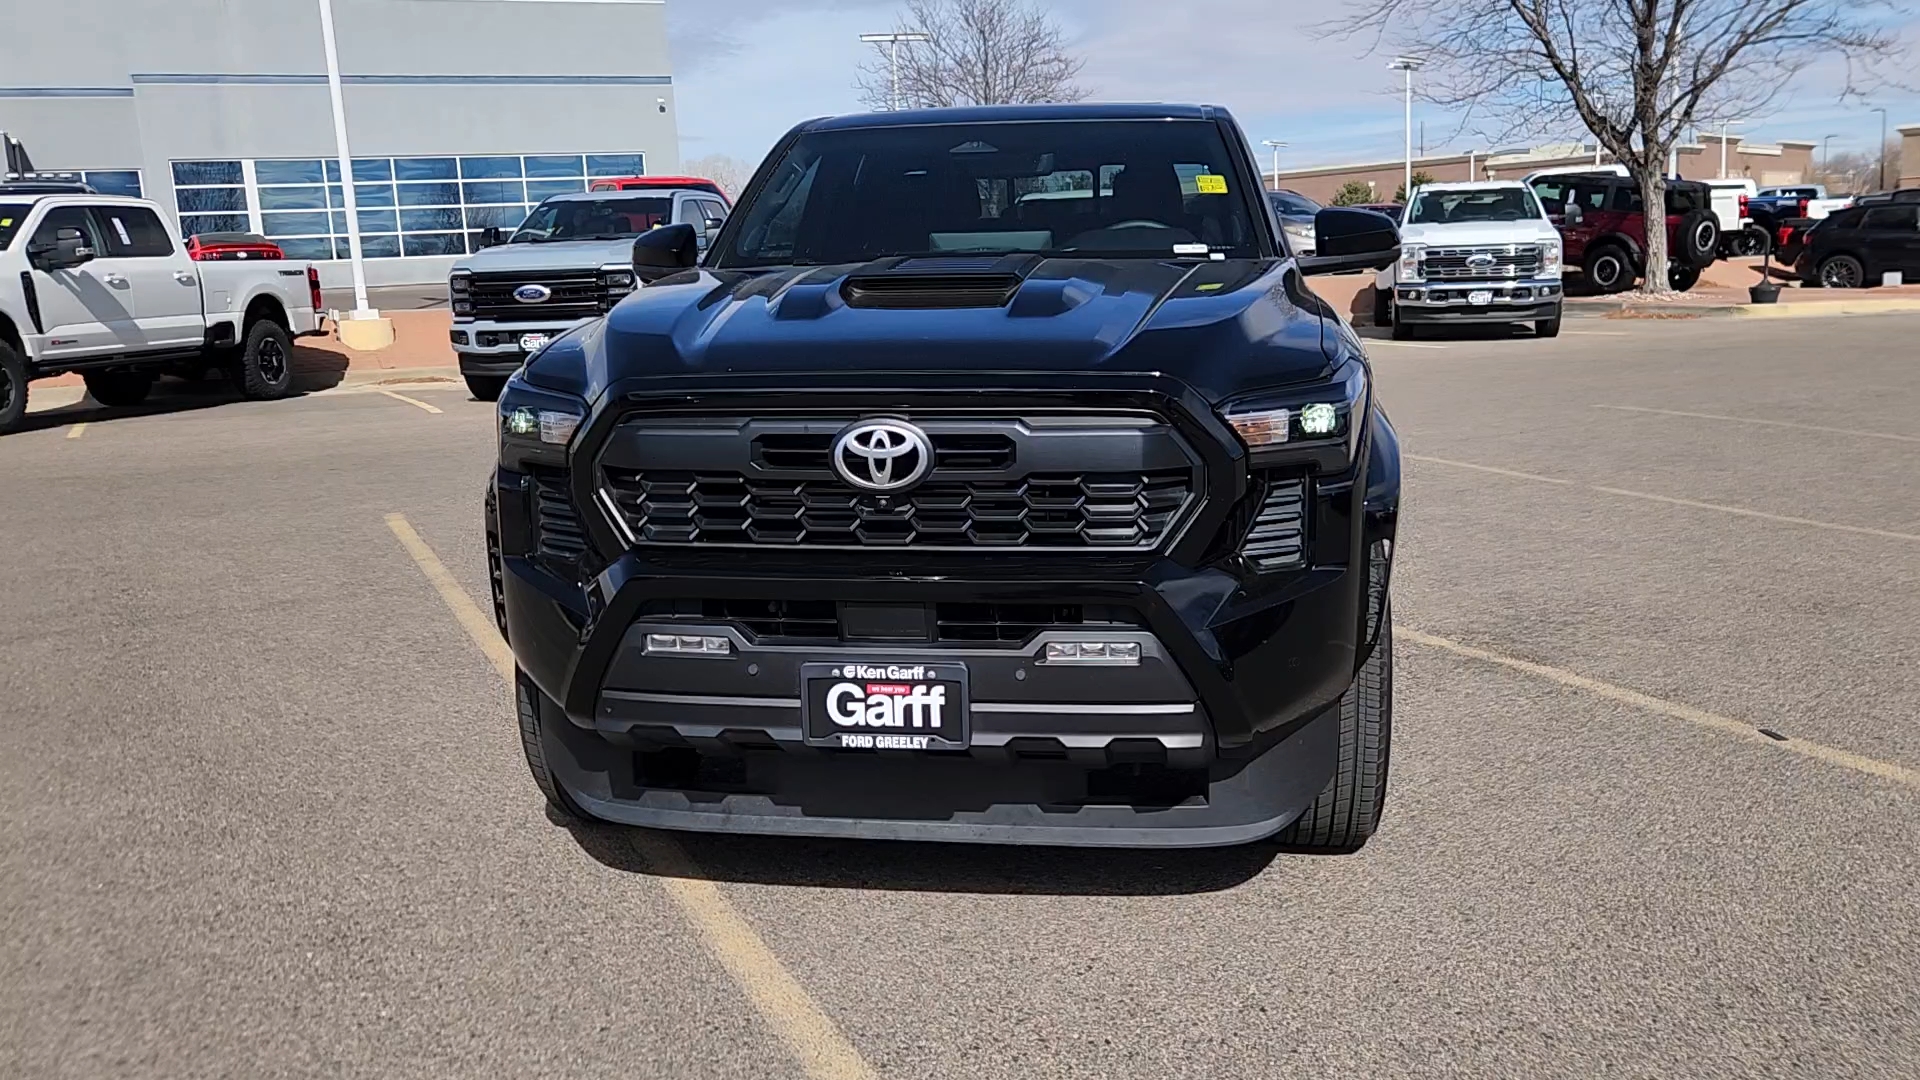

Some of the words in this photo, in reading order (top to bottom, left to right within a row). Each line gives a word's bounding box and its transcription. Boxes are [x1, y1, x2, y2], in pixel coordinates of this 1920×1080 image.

[856, 665, 886, 679] Ken
[886, 666, 925, 680] Garff
[826, 682, 946, 728] Garff
[841, 735, 874, 748] FORD
[875, 736, 929, 749] GREELEY
